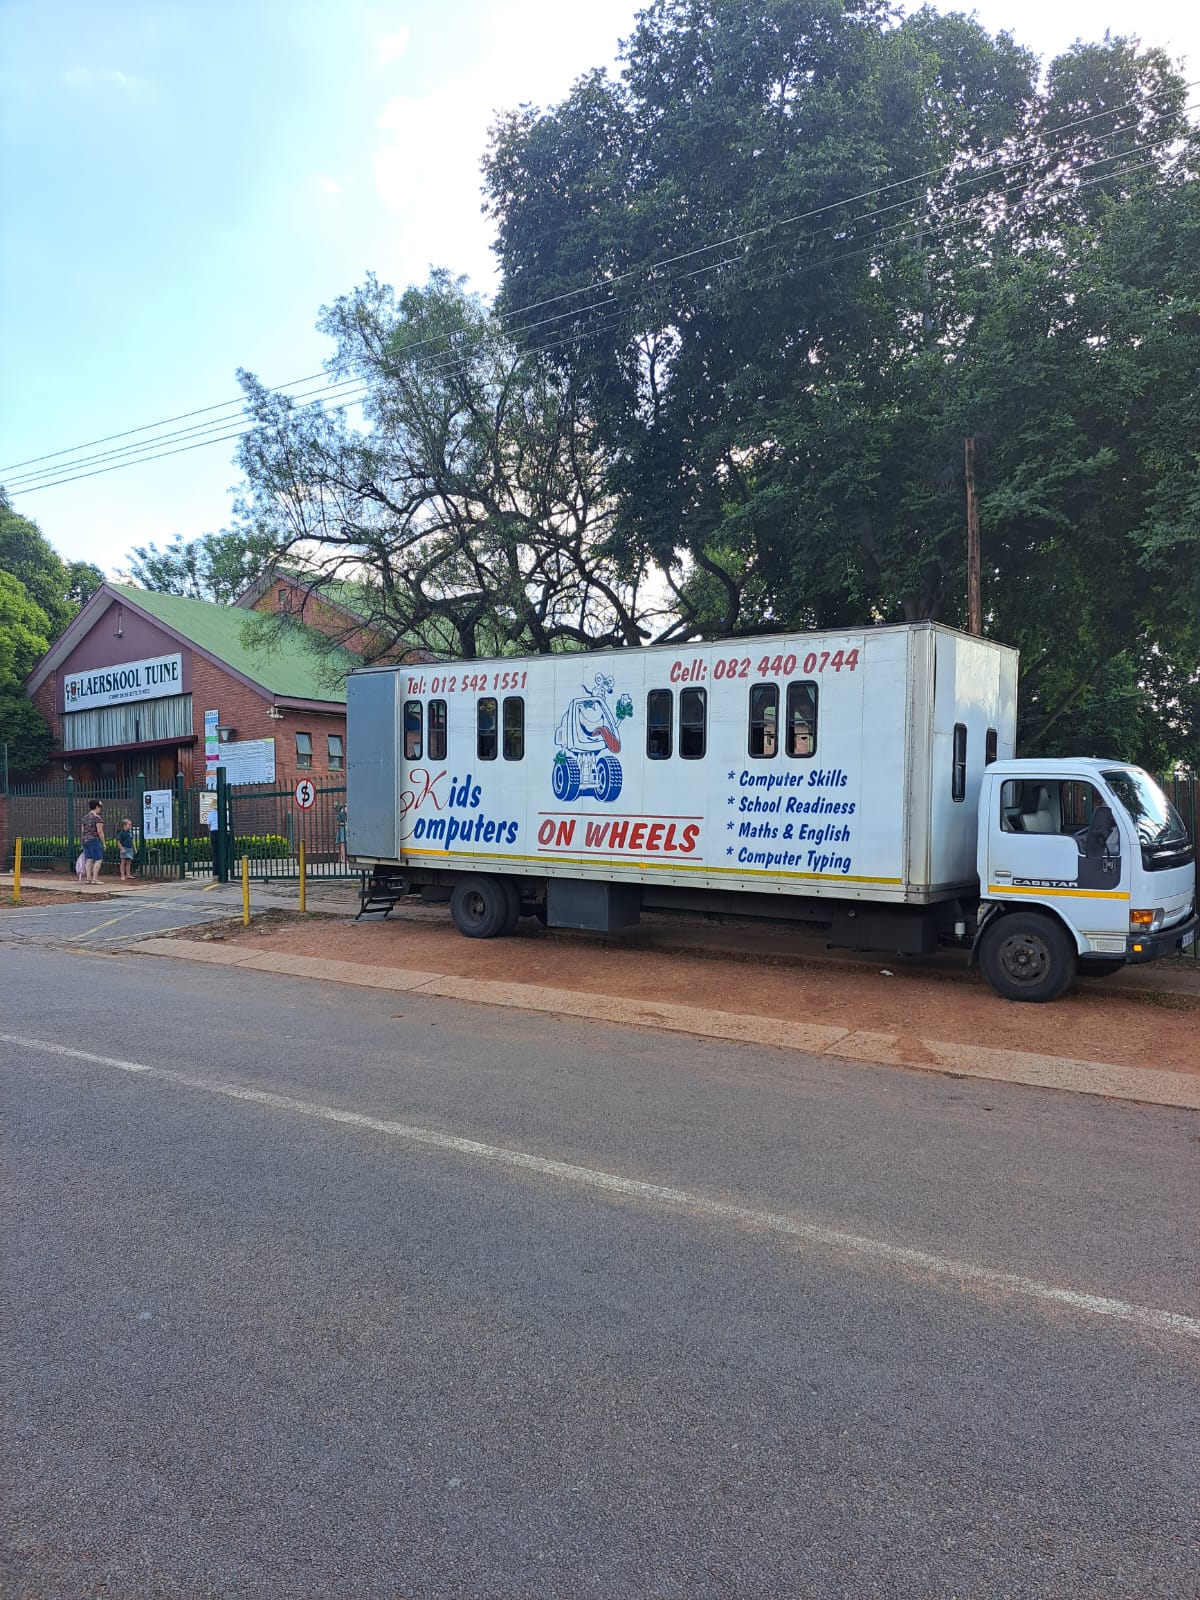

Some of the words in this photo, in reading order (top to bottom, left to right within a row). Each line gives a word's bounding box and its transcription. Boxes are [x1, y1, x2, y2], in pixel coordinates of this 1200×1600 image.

[670, 659, 708, 682] Cell:
[713, 658, 750, 680] 082
[757, 654, 797, 677] 440
[803, 649, 859, 674] 0744
[81, 669, 141, 696] LAERSKOOL
[145, 662, 178, 685] TUINE
[407, 676, 426, 694] Tel:
[431, 676, 457, 693] 012
[461, 674, 488, 692] 542
[493, 672, 527, 690] 1551
[409, 768, 482, 811] Kids
[740, 770, 803, 791] Computer
[808, 769, 848, 787] Skills
[739, 796, 782, 812] School
[786, 797, 856, 814] Readiness
[538, 819, 576, 846] ON
[585, 820, 700, 853] WHEELS
[739, 822, 778, 838] Maths
[783, 823, 793, 839] &
[799, 824, 850, 845] English
[738, 847, 802, 869] Computer
[808, 850, 851, 874] Typing
[1014, 879, 1079, 888] CABSTAR
